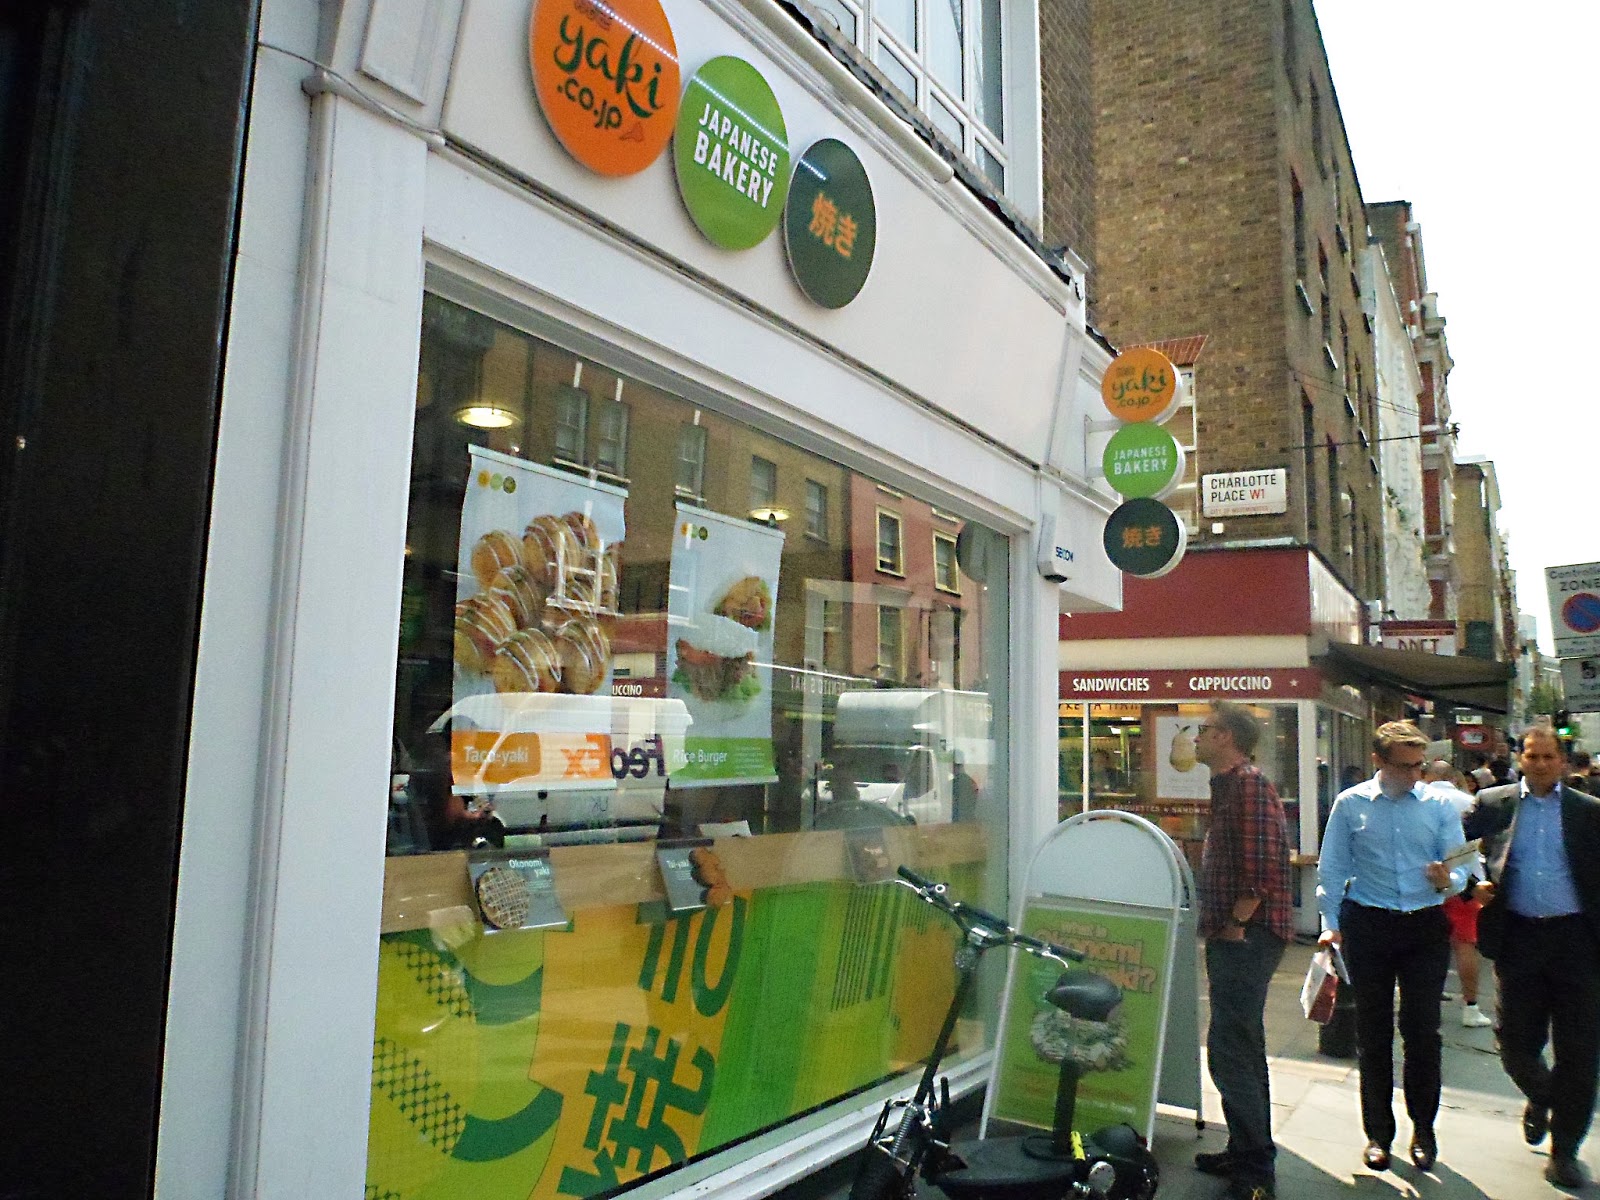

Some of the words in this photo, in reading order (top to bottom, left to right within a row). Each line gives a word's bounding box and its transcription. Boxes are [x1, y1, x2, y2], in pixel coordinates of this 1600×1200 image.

[553, 12, 663, 119] yaki
[699, 103, 778, 177] JAPANESE
[693, 130, 775, 209] BAKERY
[808, 191, 858, 258] 焼き
[1111, 366, 1167, 400] yaki
[1114, 446, 1168, 460] JAPANESE
[1113, 458, 1169, 476] BAKERY
[1210, 474, 1277, 490] CHARLOTTE
[1210, 488, 1246, 503] PLACE
[1250, 487, 1266, 501] W1
[1121, 525, 1163, 549] 焼き
[1559, 577, 1600, 592] ZONE
[1072, 677, 1150, 692] SANDWICHES
[1188, 676, 1272, 691] CAPPUCCINO
[672, 748, 696, 764] Rice
[697, 749, 728, 766] Burger
[508, 857, 543, 869] Okonomi
